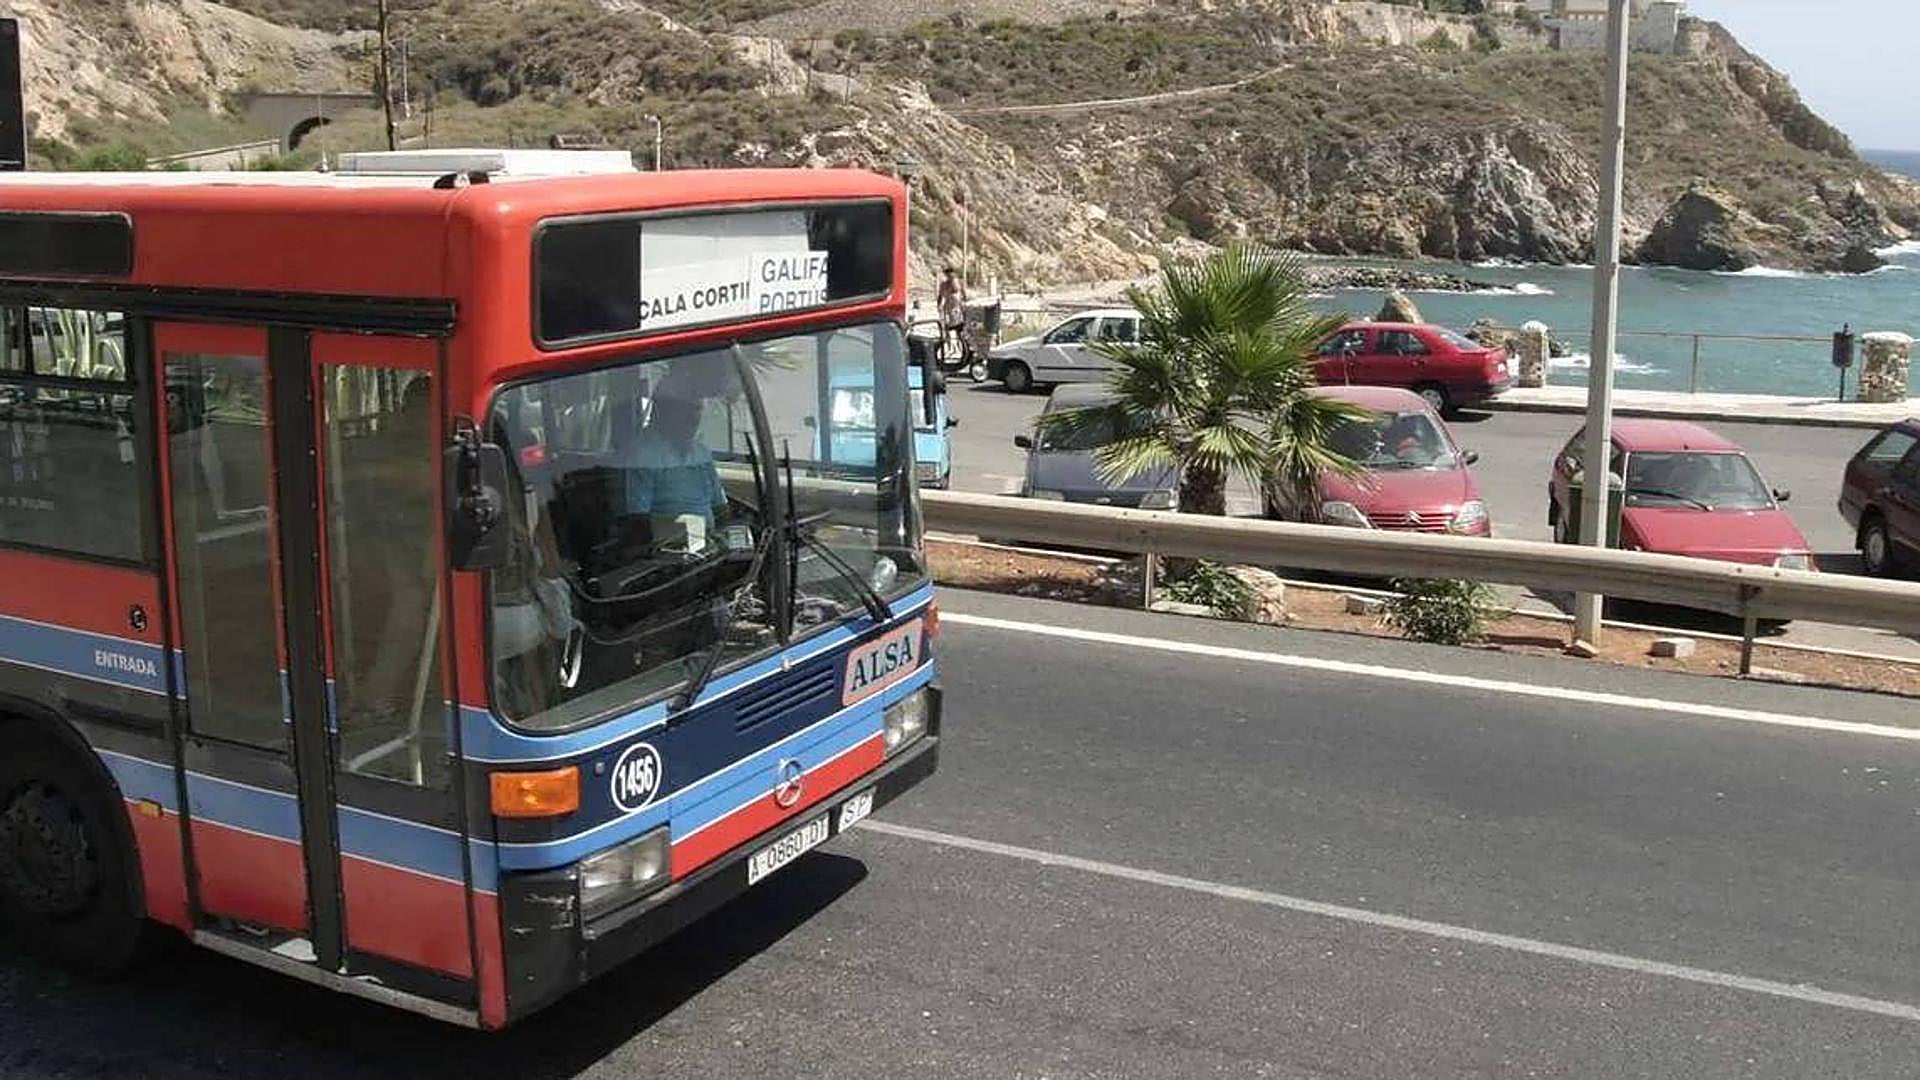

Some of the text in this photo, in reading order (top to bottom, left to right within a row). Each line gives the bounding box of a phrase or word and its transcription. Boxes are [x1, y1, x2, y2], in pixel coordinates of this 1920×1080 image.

[640, 294, 687, 321] CALA
[95, 649, 158, 676] ENTRADA
[851, 634, 914, 692] ALSA
[618, 754, 654, 801] 1456
